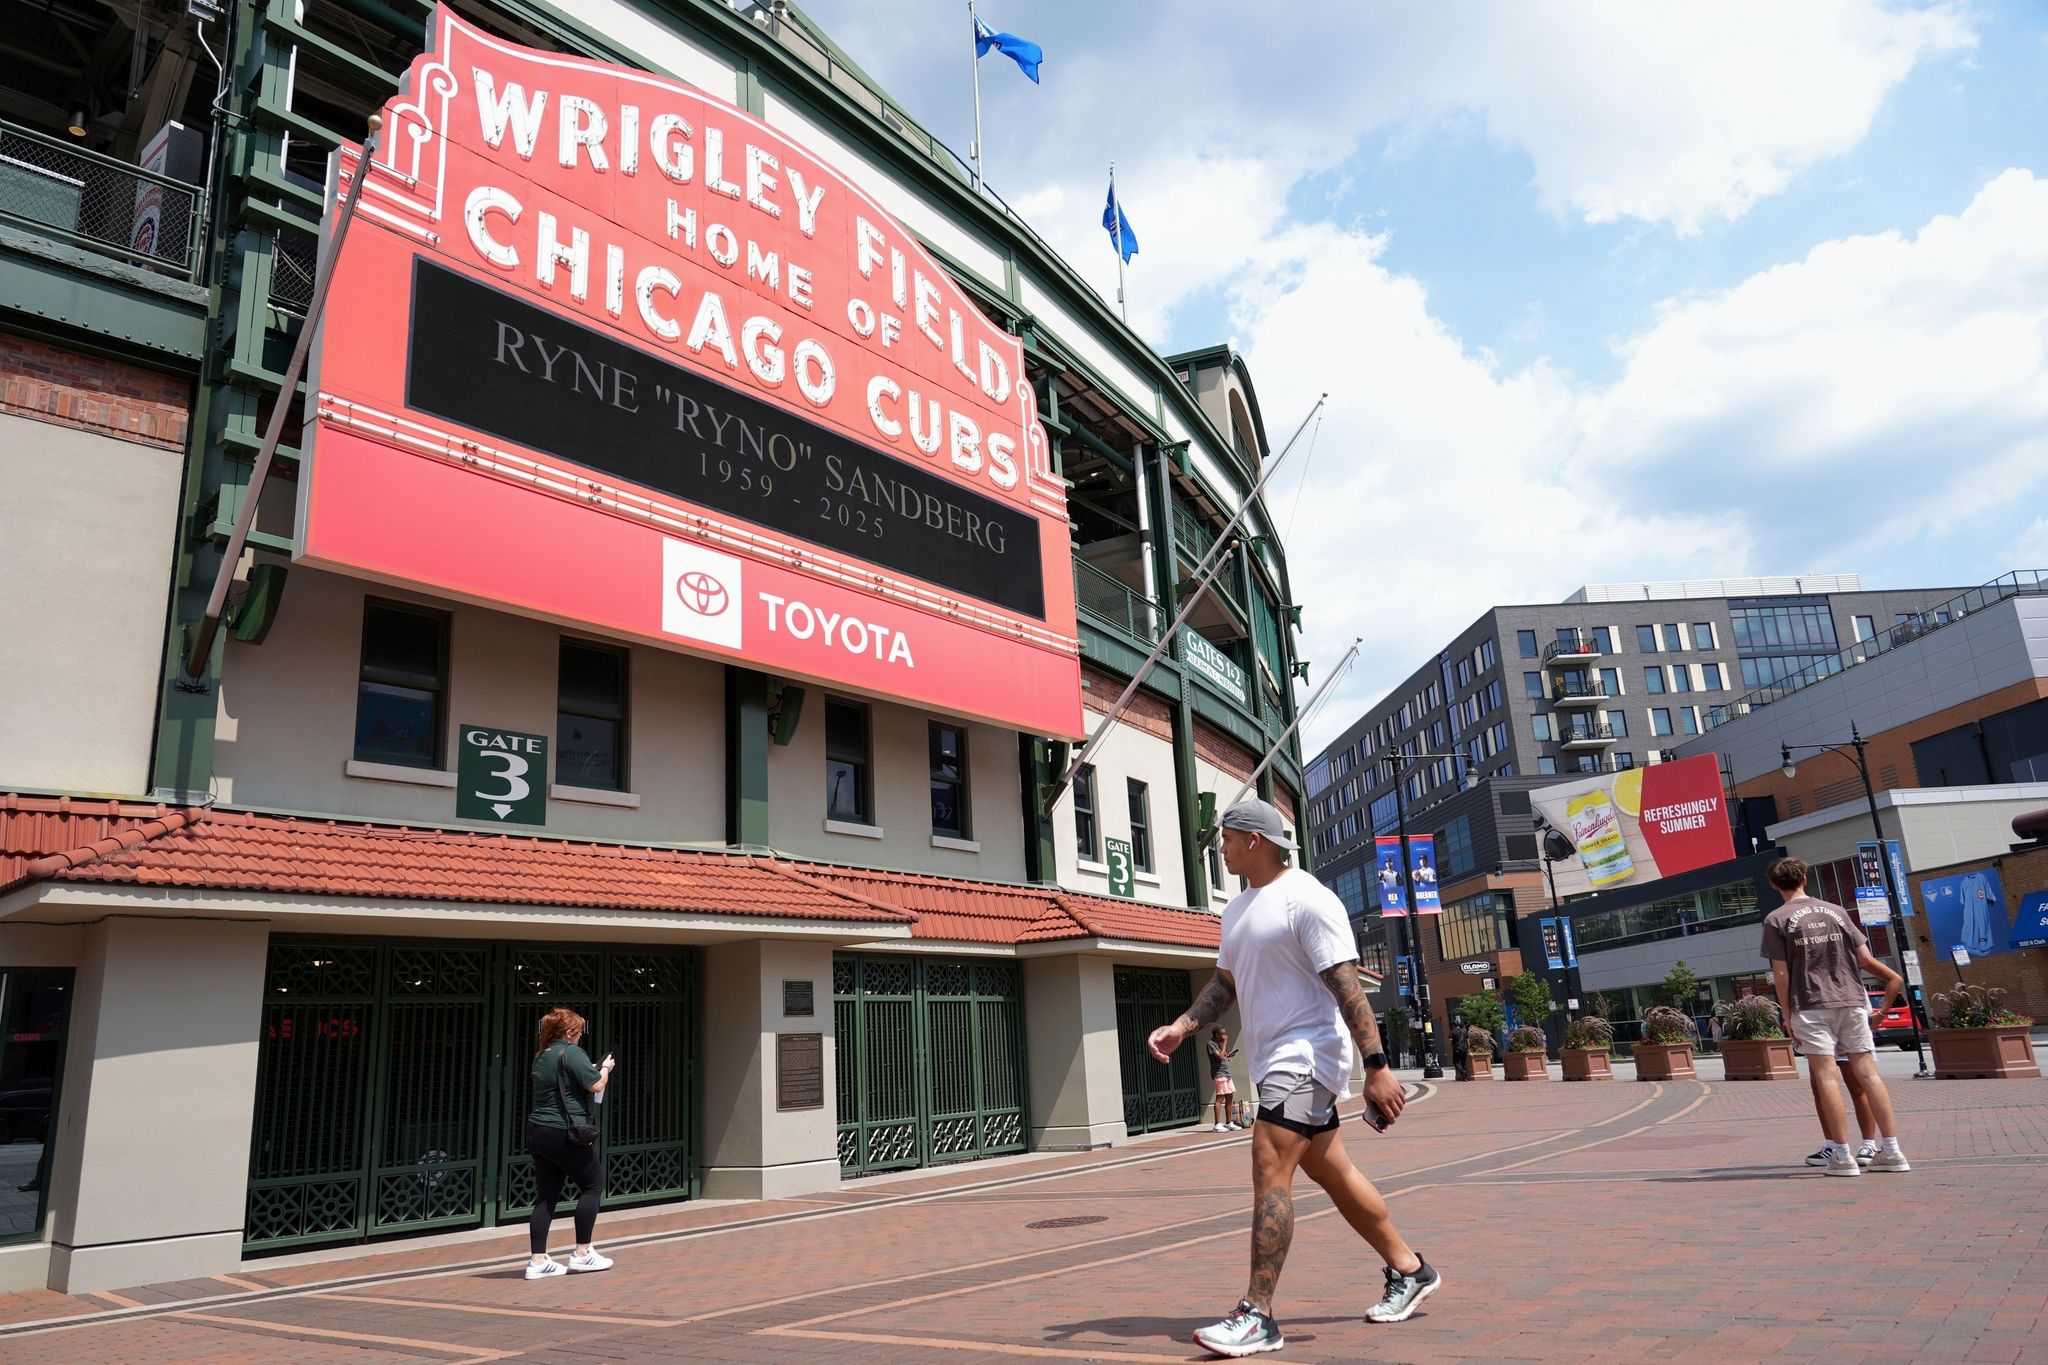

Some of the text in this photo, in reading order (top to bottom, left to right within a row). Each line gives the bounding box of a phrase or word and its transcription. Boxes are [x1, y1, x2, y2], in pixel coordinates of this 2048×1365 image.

[472, 65, 1011, 405] WRIGLEY FIELD
[666, 197, 902, 348] HOME OF
[465, 185, 1019, 490] CHICAGO CUBS
[493, 319, 1008, 555] RYNE "RYNO" SANDBERG
[700, 451, 774, 498] 1959
[820, 496, 885, 539] 2025
[759, 592, 914, 668] TOYOTA
[1186, 631, 1225, 673] GATES
[466, 730, 542, 754] GATE
[475, 750, 530, 801] 3
[1643, 797, 1718, 823] REFRESHINGLY
[1660, 814, 1706, 834] SUMMER
[1107, 840, 1130, 854] GATE
[1111, 852, 1129, 884] 3
[1786, 906, 1813, 933] WEEKEND
[1813, 906, 1846, 927] STUDIOS
[1794, 932, 1843, 946] NEW YORK CITY
[1463, 962, 1488, 970] ALAMO
